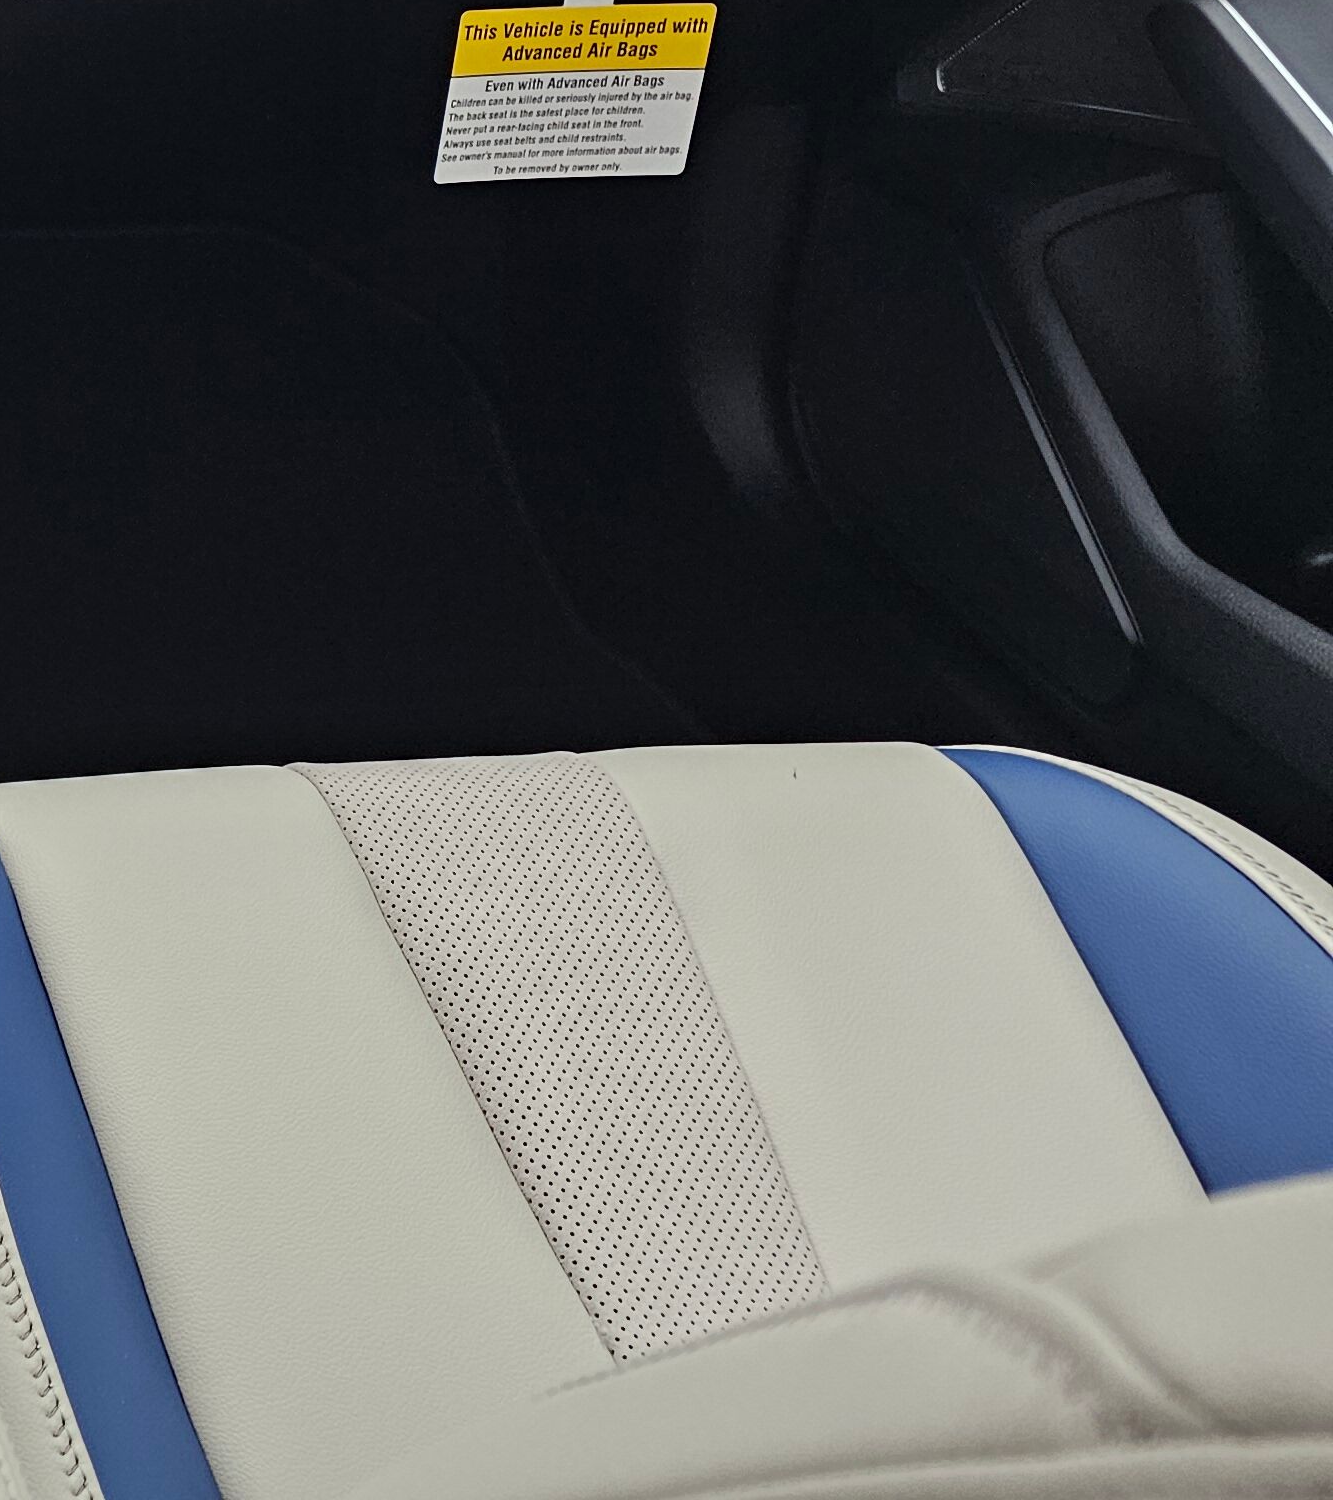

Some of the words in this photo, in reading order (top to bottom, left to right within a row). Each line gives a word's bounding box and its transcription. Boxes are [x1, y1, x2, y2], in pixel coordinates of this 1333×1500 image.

[464, 24, 497, 41] This
[504, 22, 563, 39] Vehicle
[569, 20, 583, 36] is
[589, 18, 667, 38] Equipped
[673, 18, 708, 34] with
[502, 42, 583, 61] Advanced
[587, 42, 612, 58] Air
[617, 42, 658, 60] Bags
[485, 80, 513, 92] Even
[518, 78, 544, 91] with
[547, 75, 608, 89] Advanced
[611, 75, 631, 87] Air
[633, 75, 665, 89] Bags
[450, 99, 486, 109] Children
[488, 98, 503, 106] can
[506, 96, 516, 105] be
[519, 95, 543, 105] killed
[545, 95, 555, 104] or
[556, 93, 596, 104] seriously
[598, 92, 629, 103] injured
[631, 92, 642, 103] by
[644, 92, 658, 101] the
[660, 92, 673, 101] air
[675, 91, 694, 102] bag.
[449, 113, 464, 122] The
[466, 112, 486, 121] back
[488, 111, 507, 120] seat
[509, 110, 518, 119] is
[520, 109, 534, 118] the
[536, 108, 563, 118] safest
[564, 107, 589, 118] place
[592, 106, 604, 116] for
[606, 106, 645, 115] children.
[446, 126, 471, 136] Never
[473, 125, 487, 135] put
[497, 122, 545, 132] rear-facing
[547, 121, 569, 131] child
[571, 120, 590, 130] seat
[593, 120, 601, 129] in
[603, 119, 617, 128] the
[619, 119, 643, 128] front.
[443, 140, 473, 150] Always
[476, 139, 491, 147] use
[494, 137, 512, 146] seat
[514, 136, 536, 145] belts
[538, 135, 555, 144] and
[557, 133, 579, 143] child
[581, 133, 626, 143] restraints.
[441, 154, 457, 162] See
[459, 151, 492, 161] owner's
[494, 150, 526, 159] manual
[527, 149, 539, 158] for
[542, 148, 564, 157] more
[566, 147, 616, 157] information
[618, 146, 642, 155] about
[644, 146, 657, 154] air
[659, 146, 682, 156] bags.
[494, 166, 503, 175] To
[505, 165, 516, 174] be
[518, 164, 557, 173] removed
[559, 164, 569, 174] by
[572, 163, 599, 171] owner
[601, 162, 622, 172] only.
